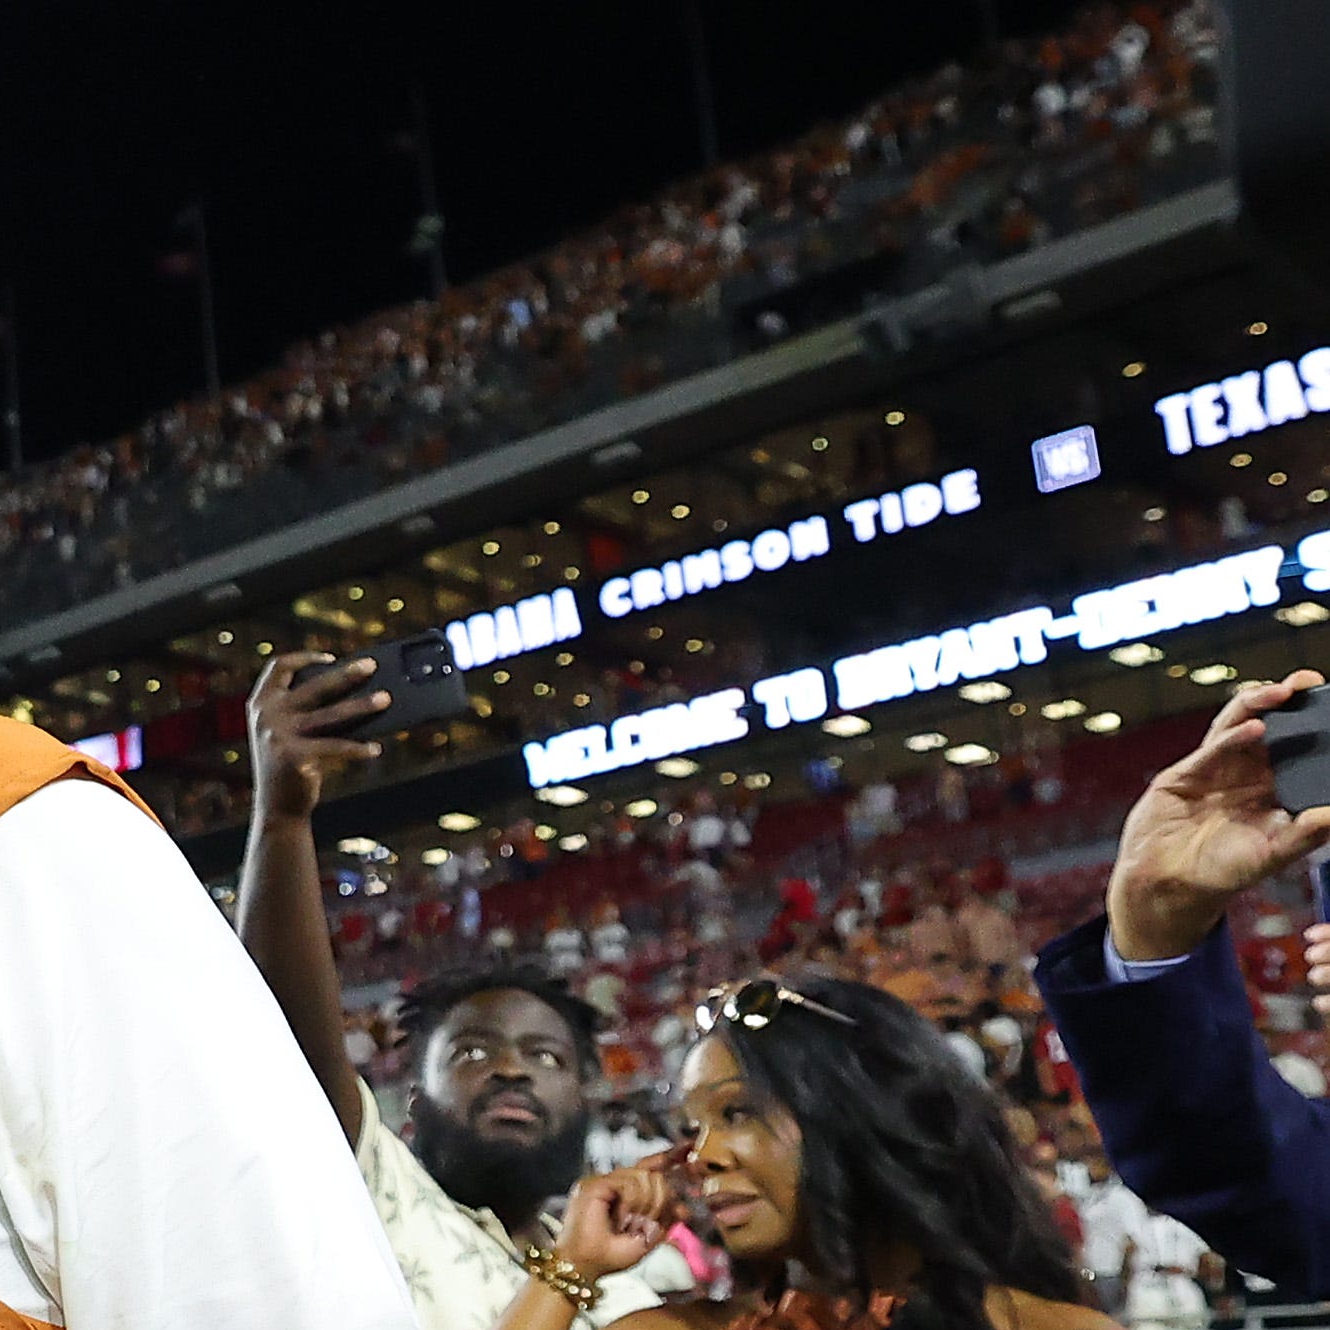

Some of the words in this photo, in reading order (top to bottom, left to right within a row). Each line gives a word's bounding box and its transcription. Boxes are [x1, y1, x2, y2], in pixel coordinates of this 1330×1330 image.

[599, 515, 830, 618] CRIMSON
[843, 467, 981, 543] TIDE
[1154, 346, 1330, 455] TEXAS
[523, 687, 749, 788] WELCOME
[752, 667, 828, 729] TO
